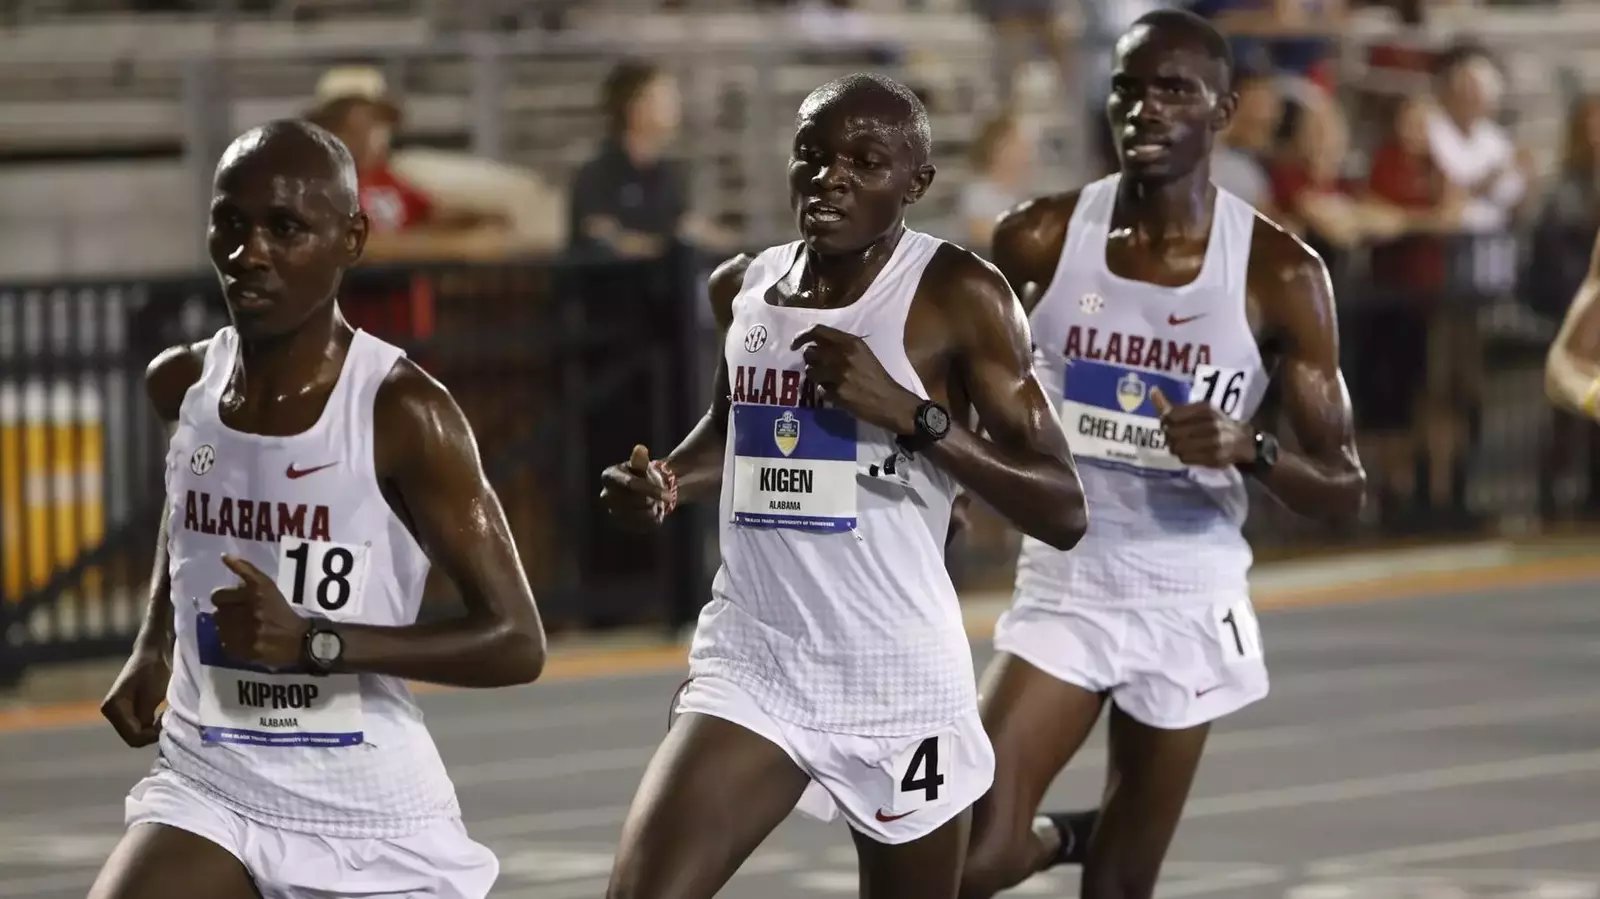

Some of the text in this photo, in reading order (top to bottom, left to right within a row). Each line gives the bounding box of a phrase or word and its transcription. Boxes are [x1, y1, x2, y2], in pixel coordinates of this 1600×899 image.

[1063, 326, 1213, 376] ALABAMA
[1202, 371, 1246, 416] 16
[1078, 414, 1169, 450] CHELANG
[759, 467, 814, 494] KIGEN
[183, 490, 332, 543] ALABAMA
[769, 500, 801, 511] ALABAMA
[285, 542, 355, 611] 18
[237, 679, 319, 709] KIPROP
[259, 717, 298, 728] ALABAMA
[900, 735, 944, 801] 4
